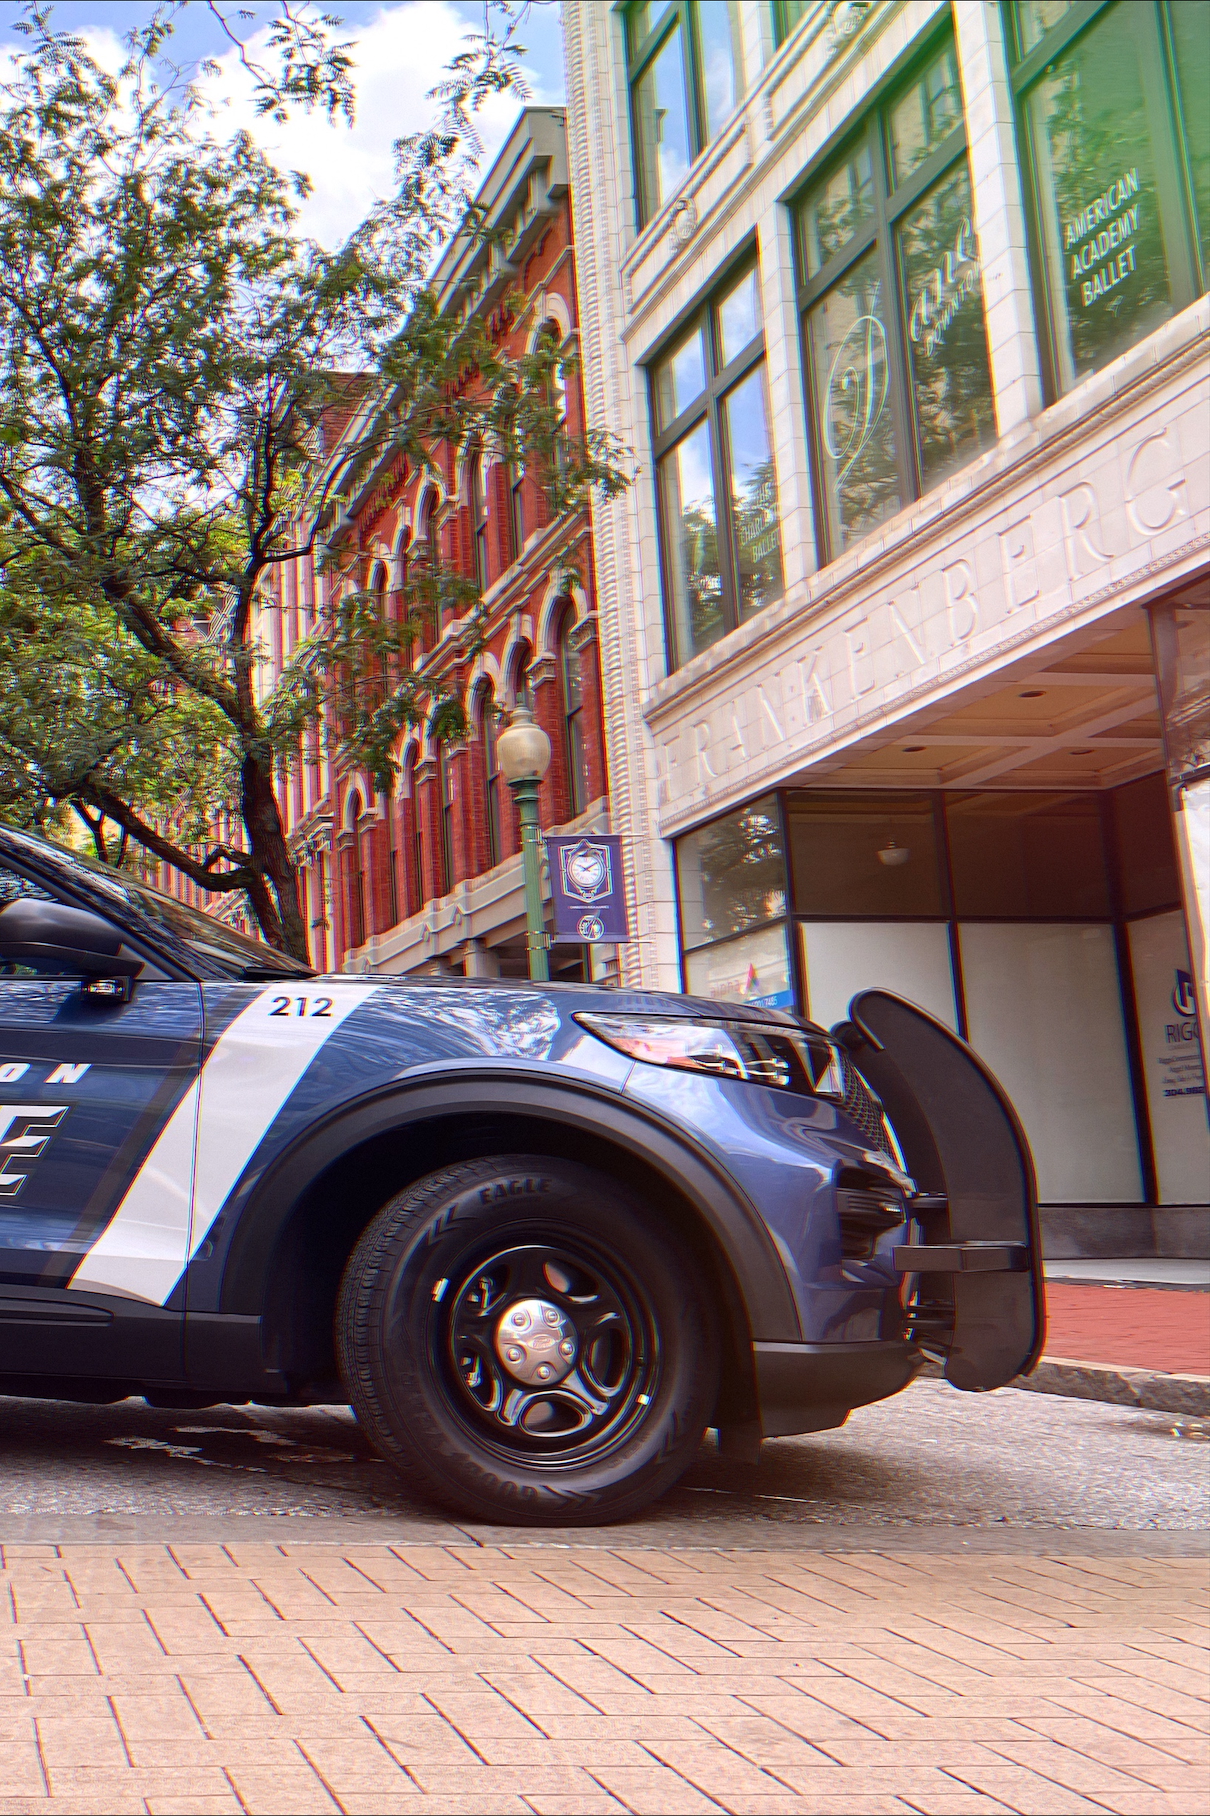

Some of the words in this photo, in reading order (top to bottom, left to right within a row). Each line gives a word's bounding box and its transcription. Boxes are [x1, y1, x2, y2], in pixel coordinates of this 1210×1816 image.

[1064, 167, 1139, 249] AMERICAN
[1071, 203, 1139, 280] ACADEMY
[1080, 244, 1136, 307] BALLET
[752, 526, 781, 564] BALLET
[660, 427, 1186, 803] FRANKENBERG
[268, 996, 333, 1018] 212
[479, 1178, 552, 1206] EAGLE
